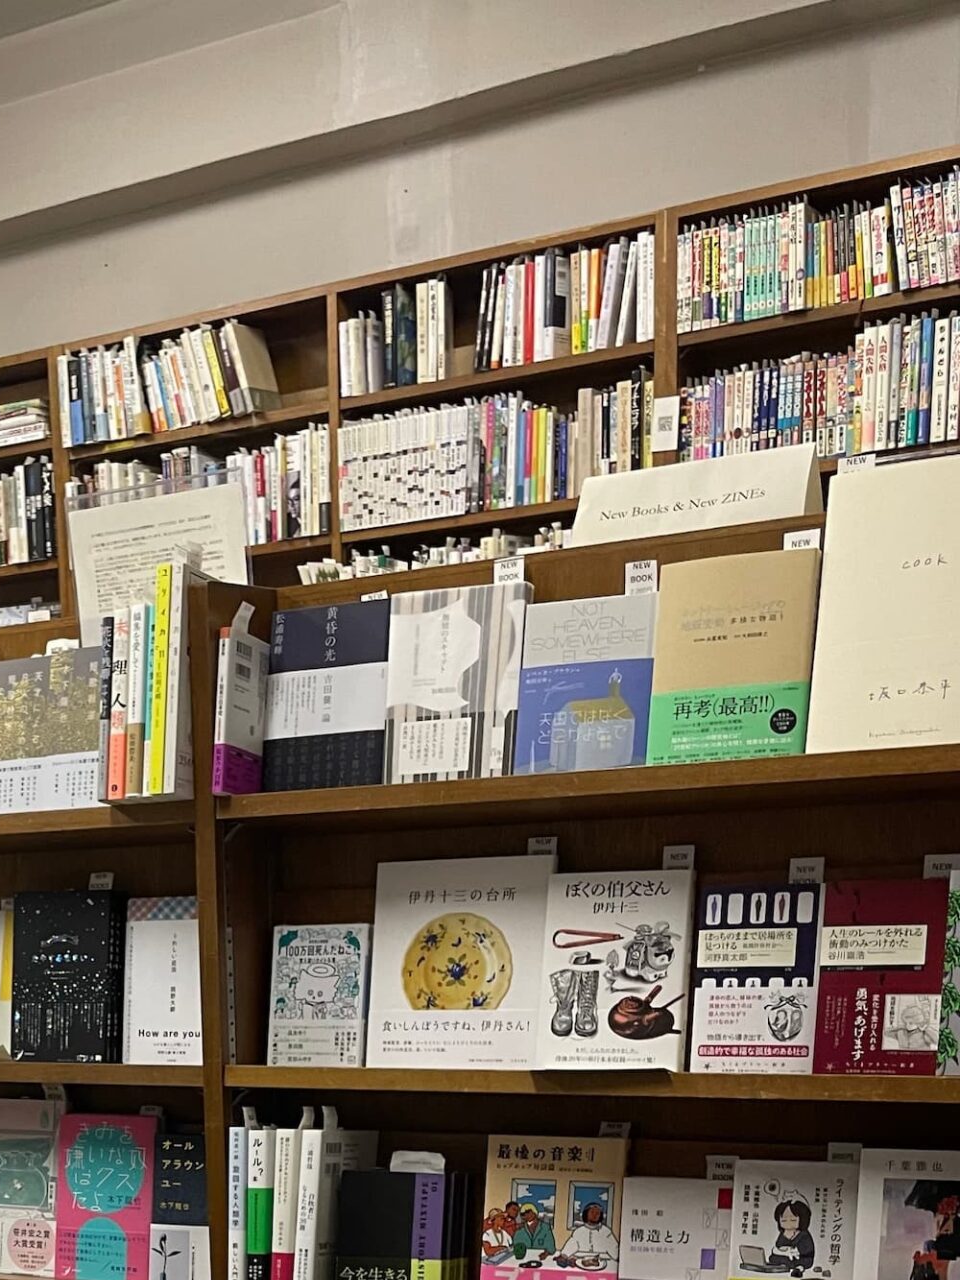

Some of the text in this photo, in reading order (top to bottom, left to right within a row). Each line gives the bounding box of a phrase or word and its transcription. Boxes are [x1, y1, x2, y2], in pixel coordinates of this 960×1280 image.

[845, 455, 867, 466] NEW
[598, 487, 766, 523] New Books & New ZINEs
[790, 538, 812, 548] NEW
[632, 561, 652, 571] NEW
[900, 553, 948, 570] cook
[497, 571, 520, 582] BOOK
[629, 573, 654, 584] BOOK
[570, 600, 608, 618] NOT
[323, 605, 339, 662] 黄昏の光
[529, 626, 648, 651] SOMEWHERE
[561, 646, 611, 662] ELSE
[669, 852, 689, 861] NEW
[796, 865, 815, 874] NEW
[565, 880, 671, 899] ぼくの伯父さん
[408, 887, 518, 905] 伊丹十三の台所
[592, 901, 640, 914] 伊丹十三
[828, 927, 924, 938] 人生のレールを外れる
[704, 941, 738, 951] 見つける
[828, 938, 909, 949] 衝動のみつけかた
[137, 1028, 201, 1040] How are you
[76, 1121, 133, 1146] きみを
[161, 1139, 195, 1151] オール
[64, 1146, 148, 1170] 嫌いな奴
[714, 1162, 733, 1170] NEW
[886, 1159, 944, 1173] 千葉雅也
[161, 1179, 182, 1188] ユー
[419, 1181, 430, 1230] MIXTAPE
[828, 1178, 845, 1267] ライティングの哲学
[630, 1227, 690, 1245] 構造と力
[12, 1238, 48, 1250] 大賞受賞!
